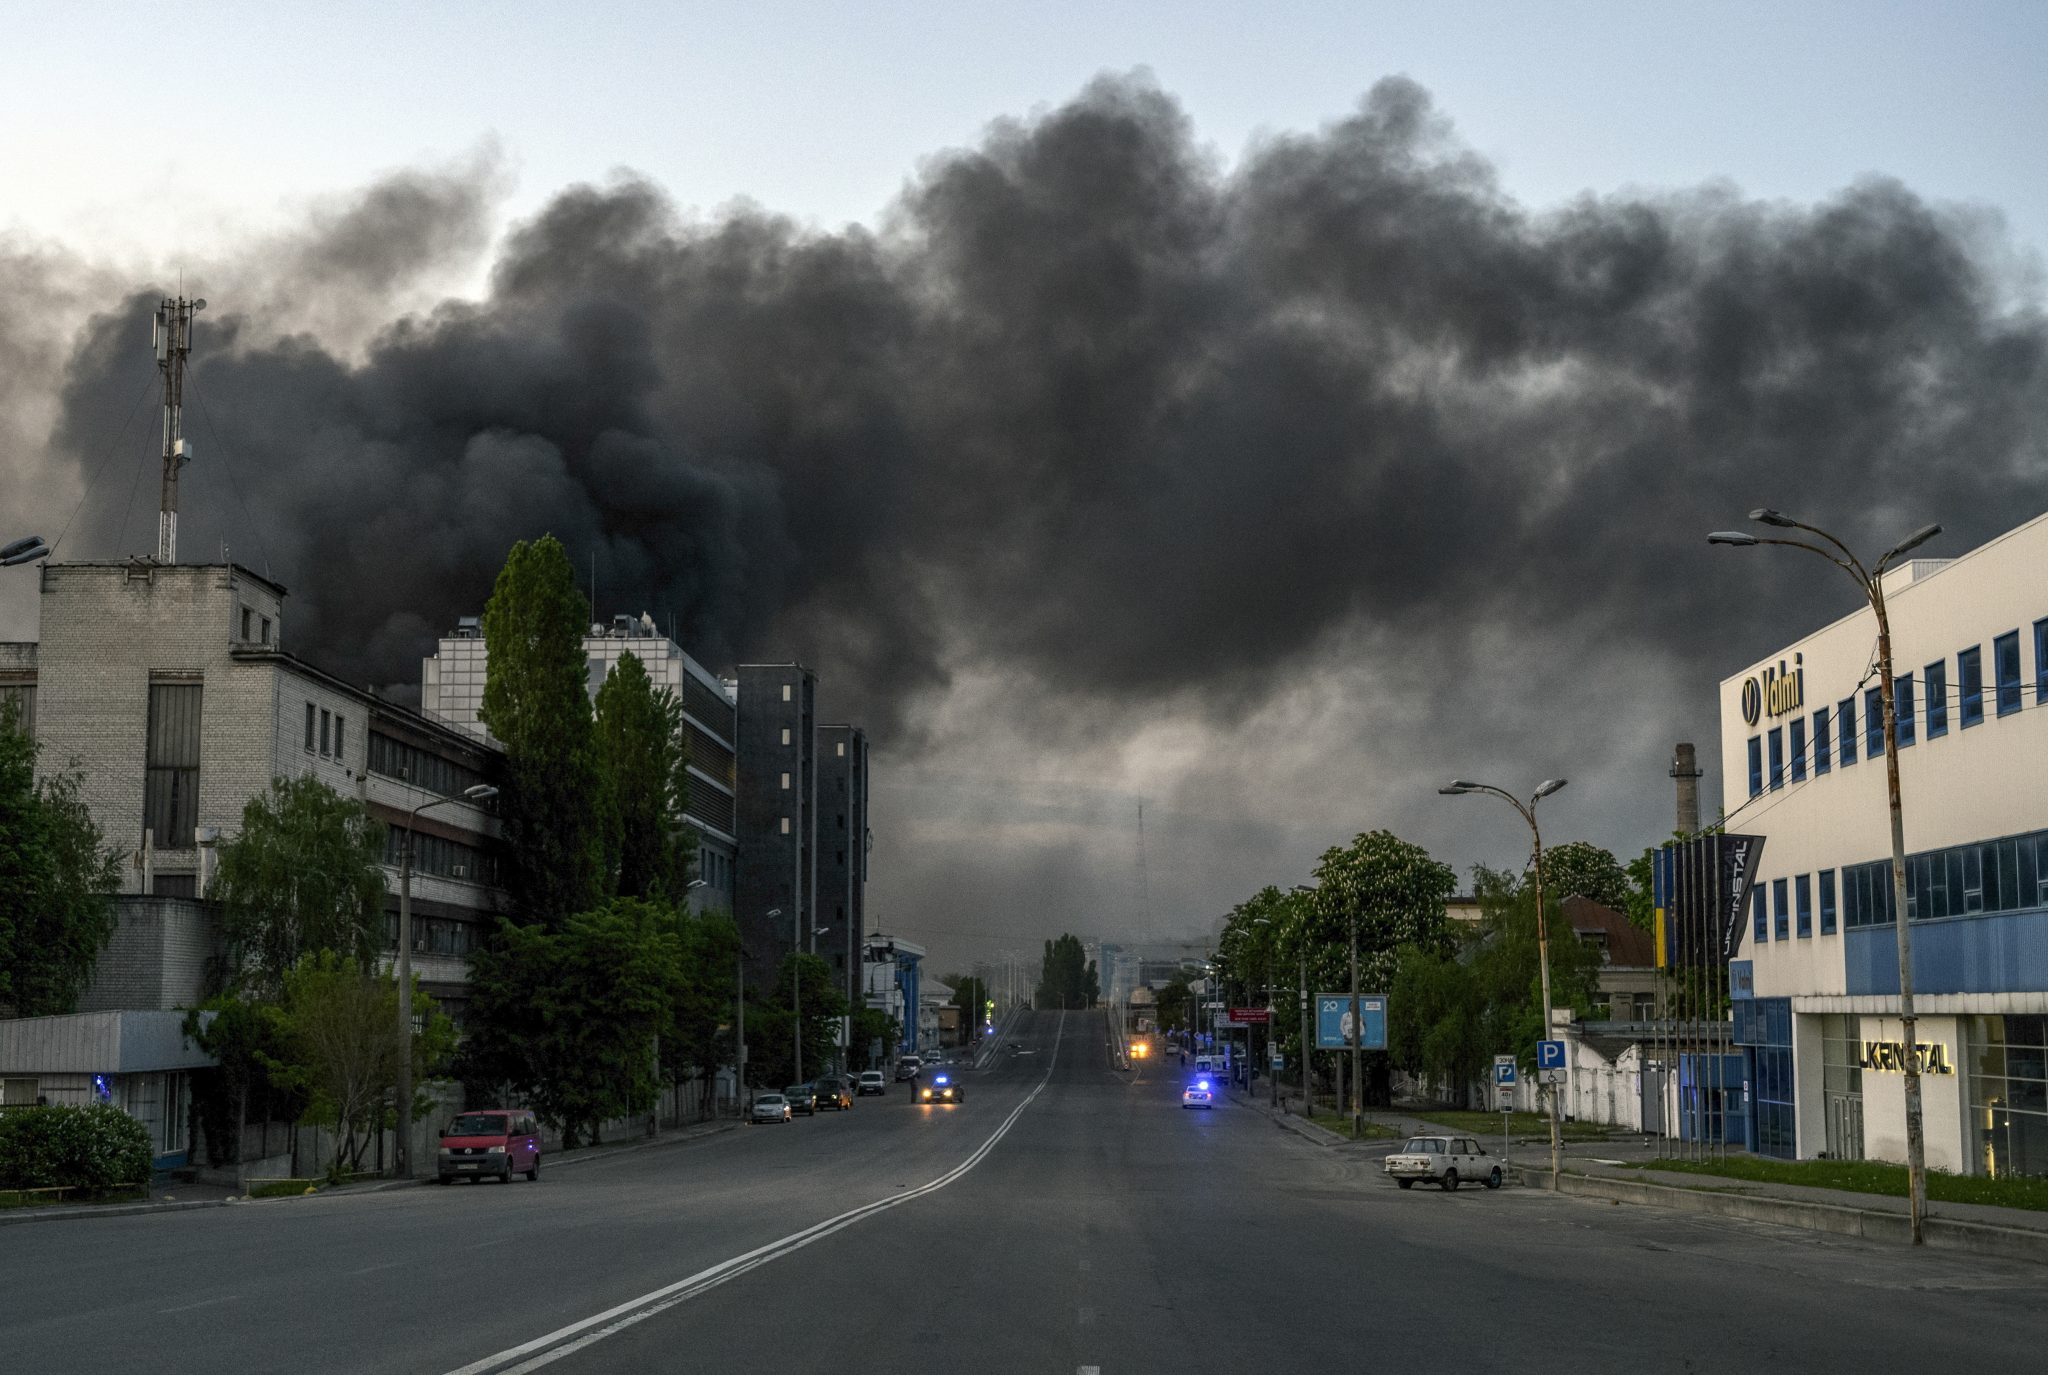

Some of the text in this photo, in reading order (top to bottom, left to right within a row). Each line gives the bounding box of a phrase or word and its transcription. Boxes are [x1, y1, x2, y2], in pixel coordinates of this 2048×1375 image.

[1762, 653, 1803, 717] Valmi
[1323, 1001, 1338, 1012] 20
[1544, 1045, 1558, 1064] P
[1859, 1041, 1953, 1075] UKRINTAL
[1499, 1067, 1511, 1081] P
